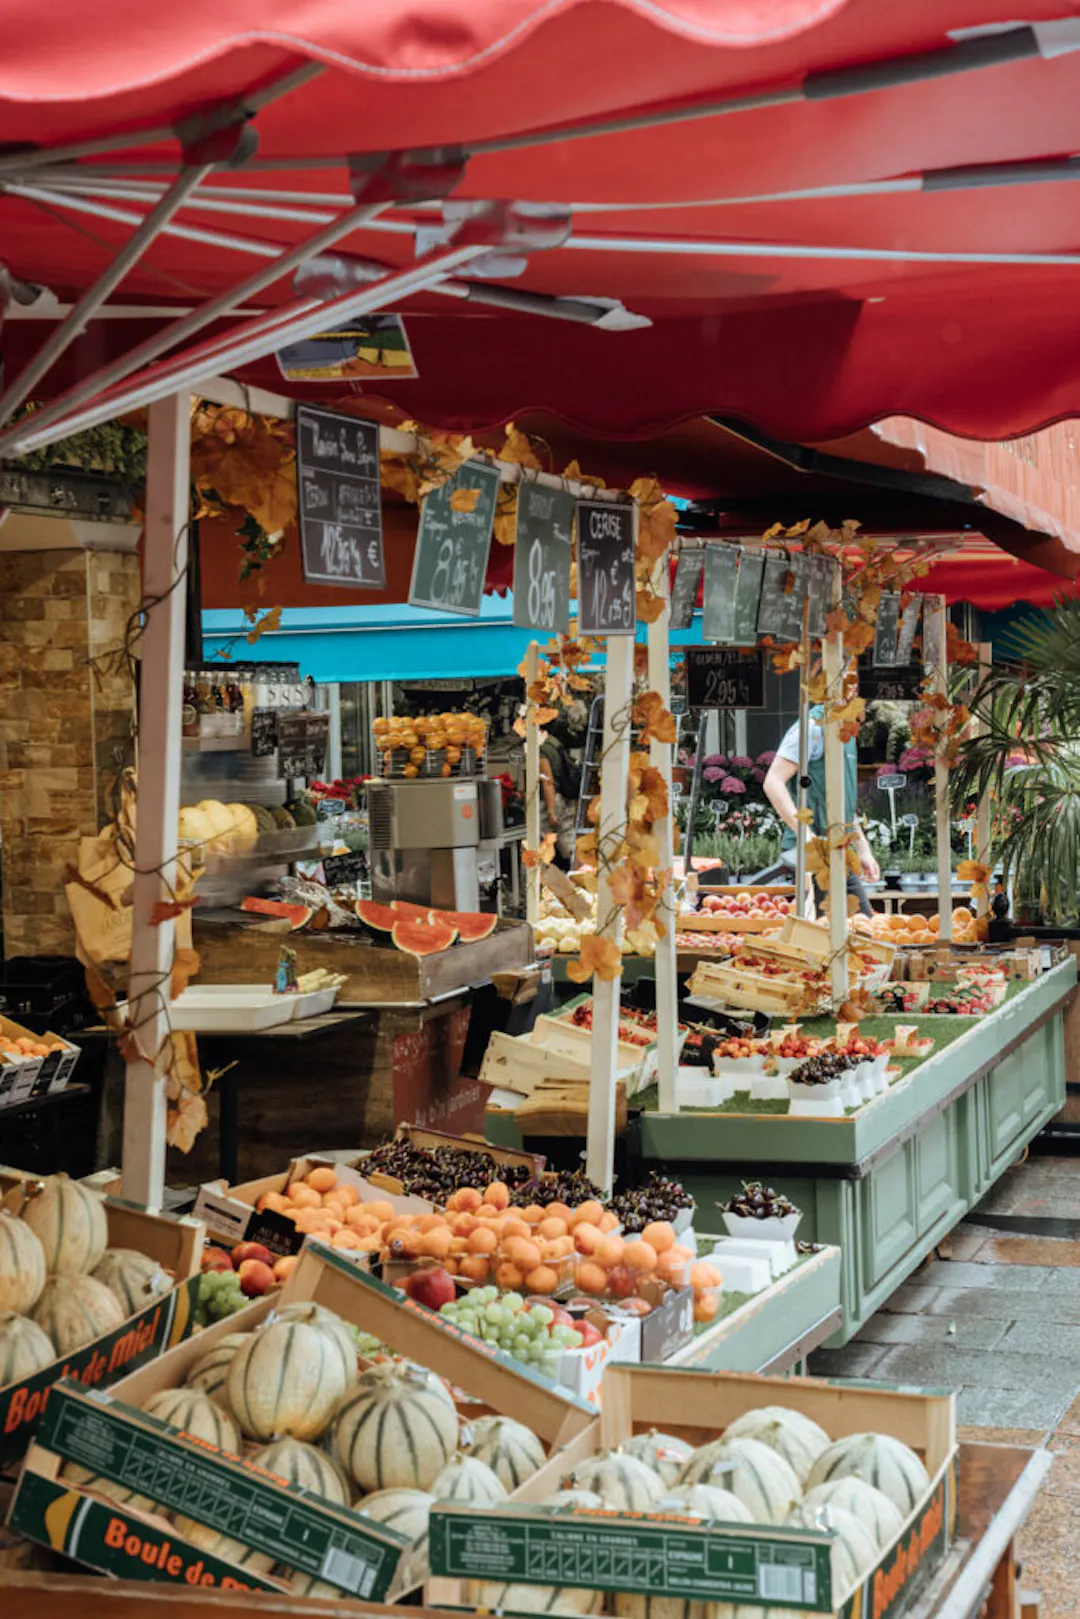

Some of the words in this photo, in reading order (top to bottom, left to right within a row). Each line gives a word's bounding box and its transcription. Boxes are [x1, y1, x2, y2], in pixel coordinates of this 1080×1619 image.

[589, 509, 622, 541] CERISE
[81, 1350, 107, 1386] de
[104, 1517, 184, 1578] Boule
[186, 1560, 217, 1590] de
